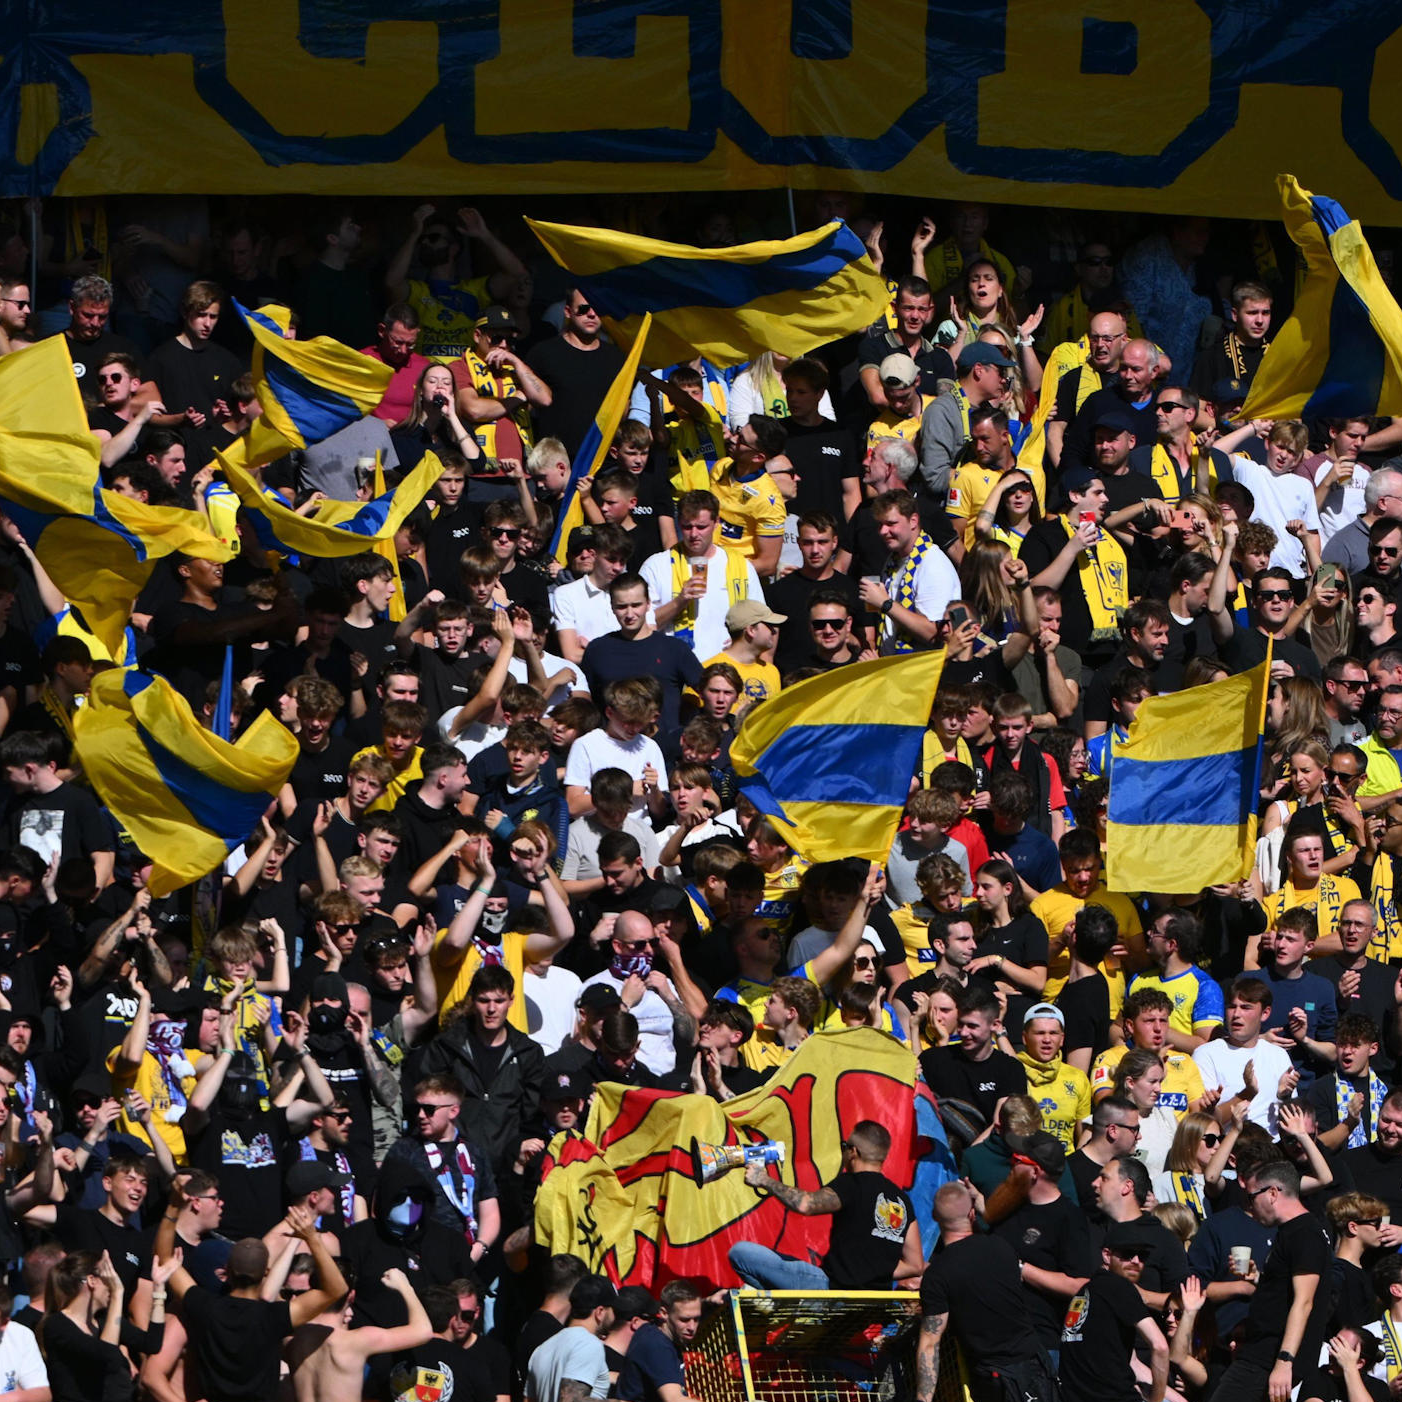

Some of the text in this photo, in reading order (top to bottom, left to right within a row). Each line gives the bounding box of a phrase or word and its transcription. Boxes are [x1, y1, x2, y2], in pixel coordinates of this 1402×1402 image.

[220, 0, 1210, 156] CLUB
[821, 446, 842, 457] 3800
[632, 506, 654, 515] 3800
[322, 774, 344, 784] 3800
